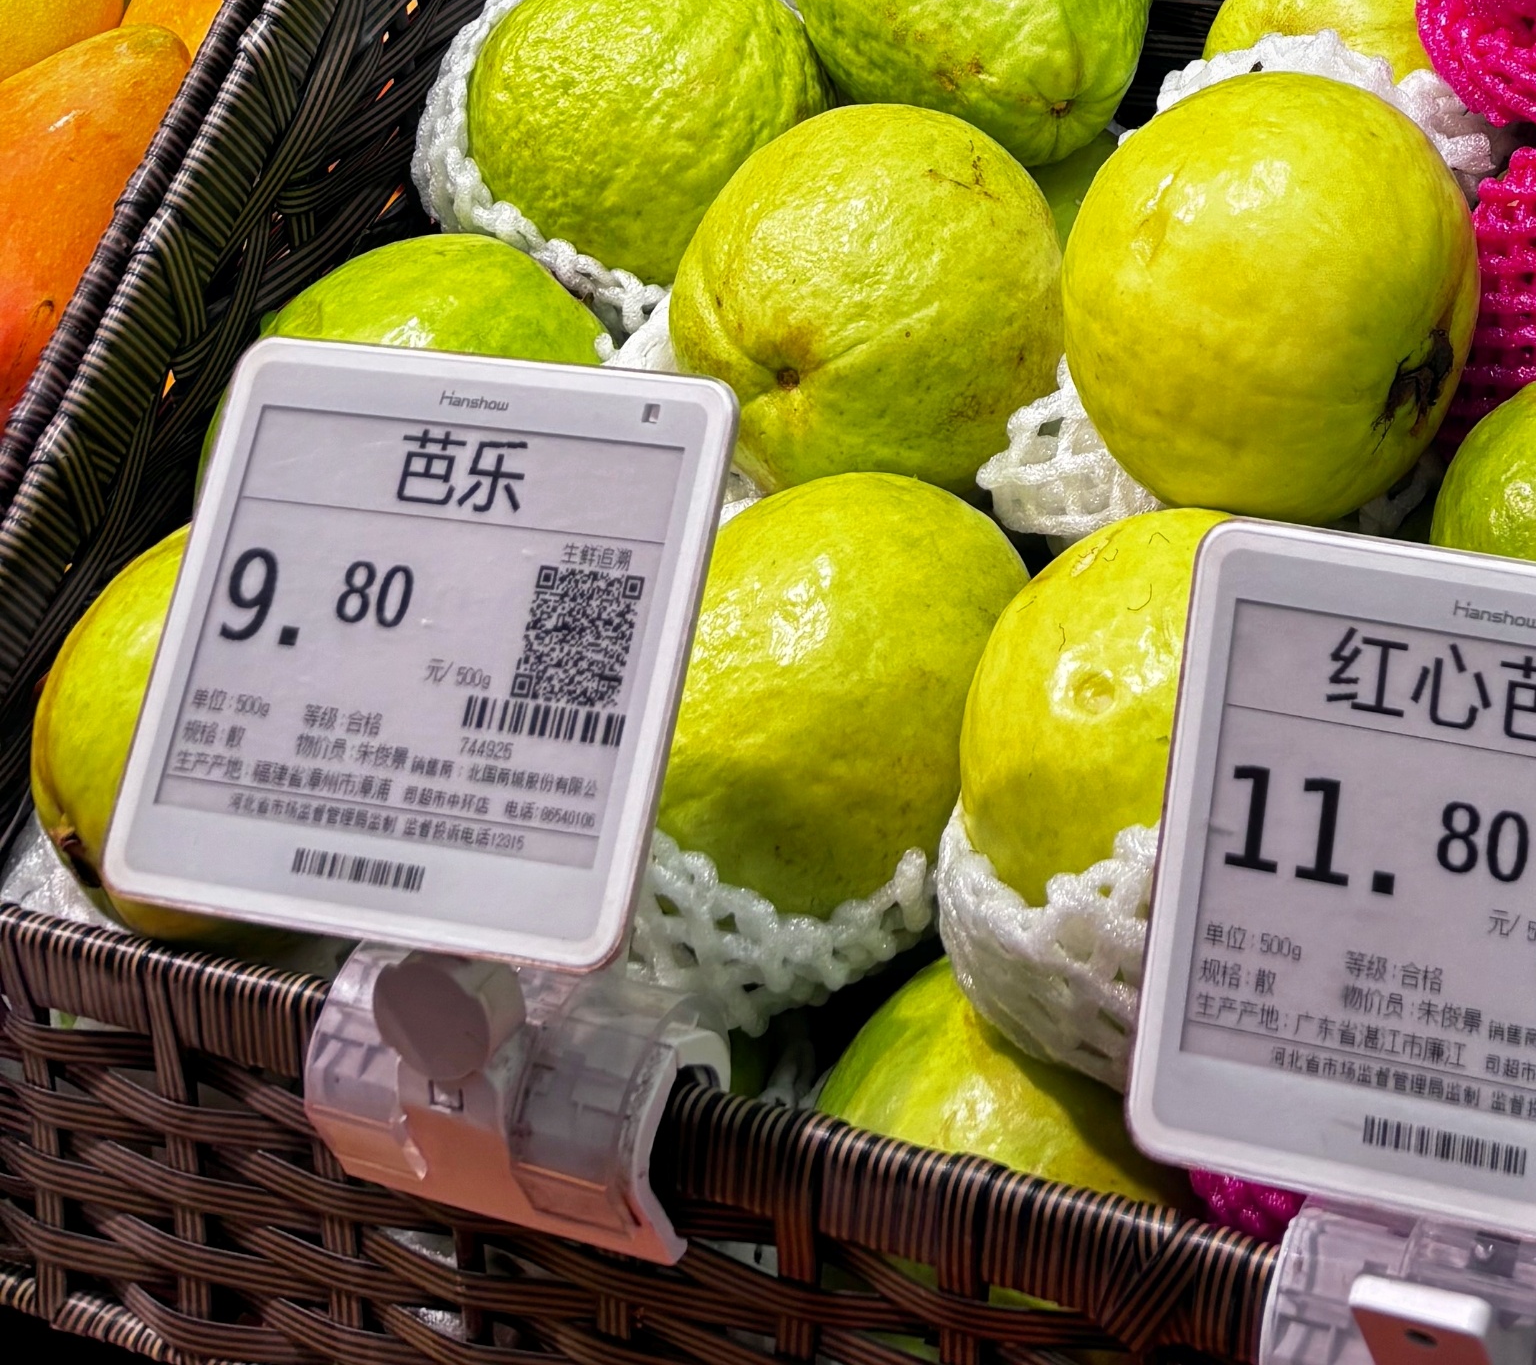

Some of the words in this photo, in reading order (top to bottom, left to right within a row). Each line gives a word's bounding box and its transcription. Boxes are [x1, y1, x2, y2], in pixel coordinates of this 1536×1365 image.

[439, 390, 510, 413] Hanshow
[397, 428, 529, 514] 芭乐
[560, 542, 633, 572] 生鲜追溯
[1270, 1046, 1480, 1109] 河北省市场监督管理局监制
